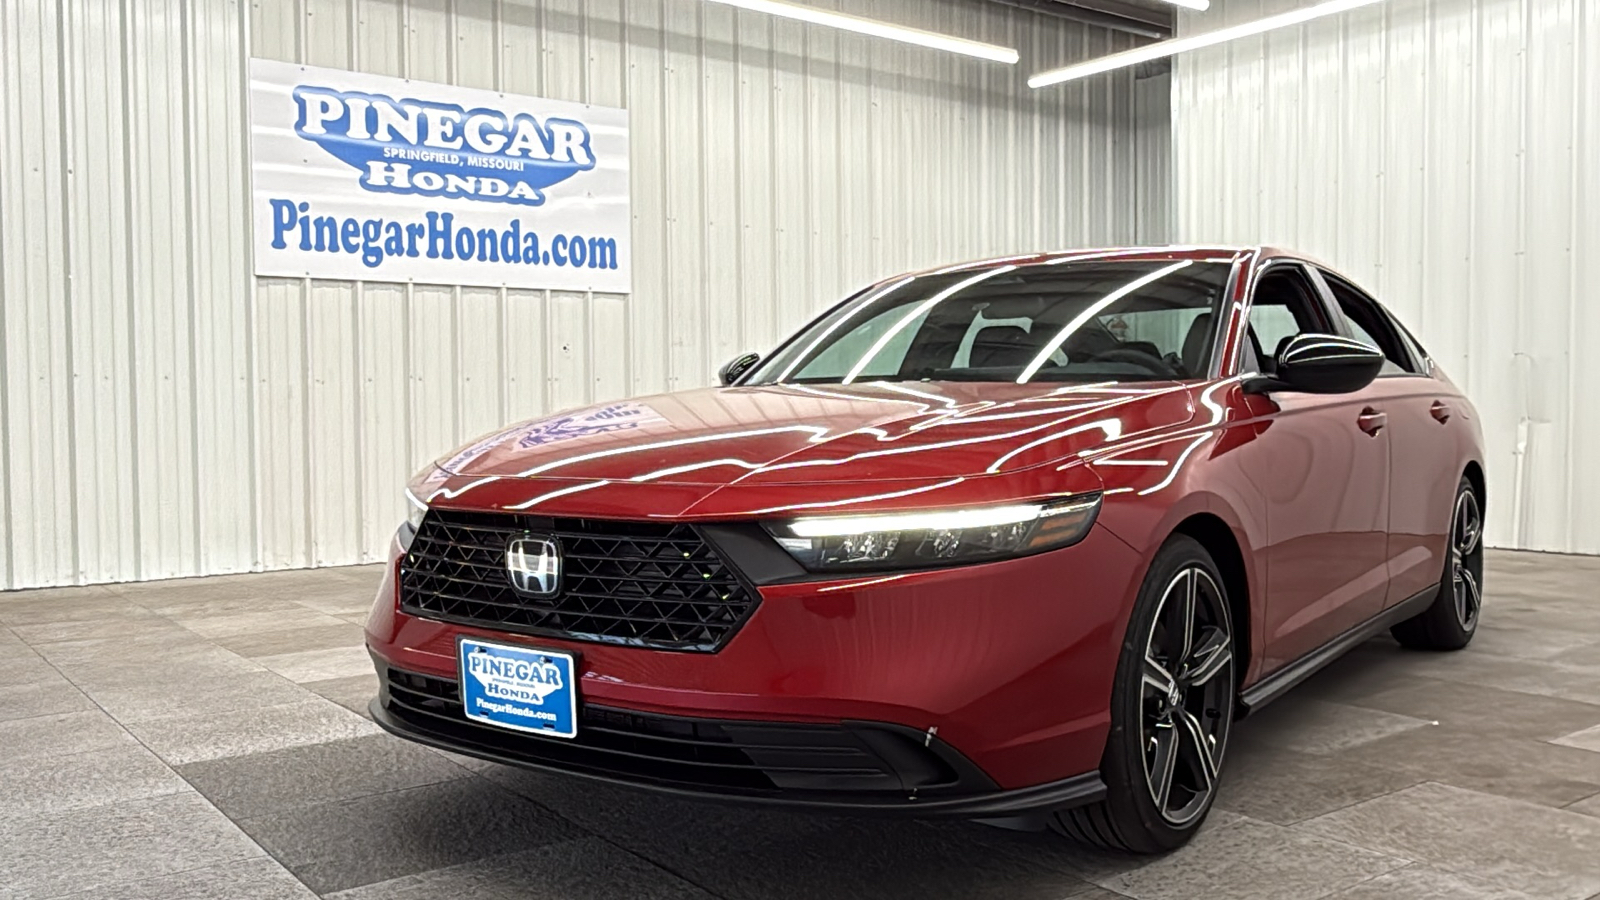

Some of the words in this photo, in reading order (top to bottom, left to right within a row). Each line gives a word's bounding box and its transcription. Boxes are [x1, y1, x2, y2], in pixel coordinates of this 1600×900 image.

[299, 92, 591, 166] PINEGAR
[383, 147, 464, 167] SPRINGFIELD,
[467, 156, 524, 172] MISSOURI
[366, 161, 540, 200] HONDA
[269, 199, 618, 269] PinegarHonda.com
[471, 656, 560, 686] PINEGAR
[487, 683, 540, 701] HONDA
[476, 697, 557, 721] PinegarHonda.com
